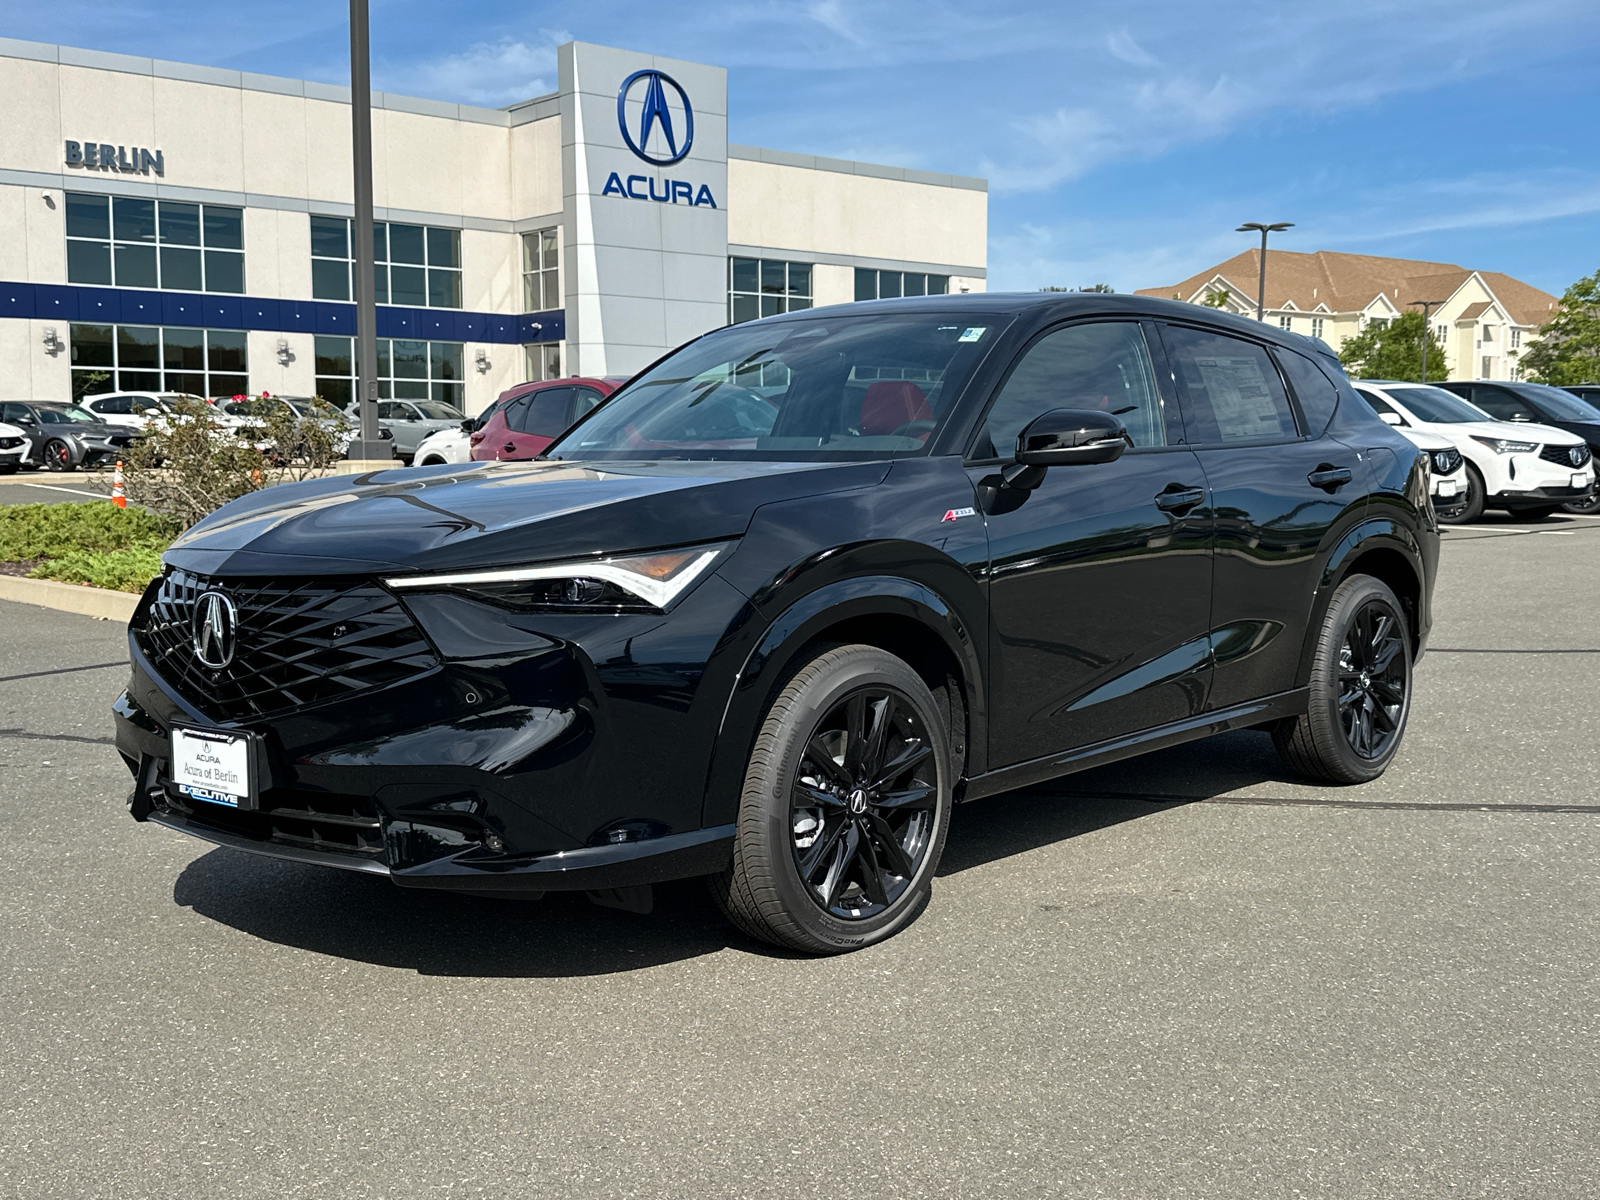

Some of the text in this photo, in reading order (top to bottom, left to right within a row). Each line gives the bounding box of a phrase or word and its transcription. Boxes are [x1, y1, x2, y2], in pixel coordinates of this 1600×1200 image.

[65, 139, 163, 176] BERLIN
[601, 171, 717, 209] ACURA
[196, 754, 221, 764] ACURA
[184, 762, 238, 783] Acura of Berlin
[179, 784, 238, 804] EXECUTIVE
